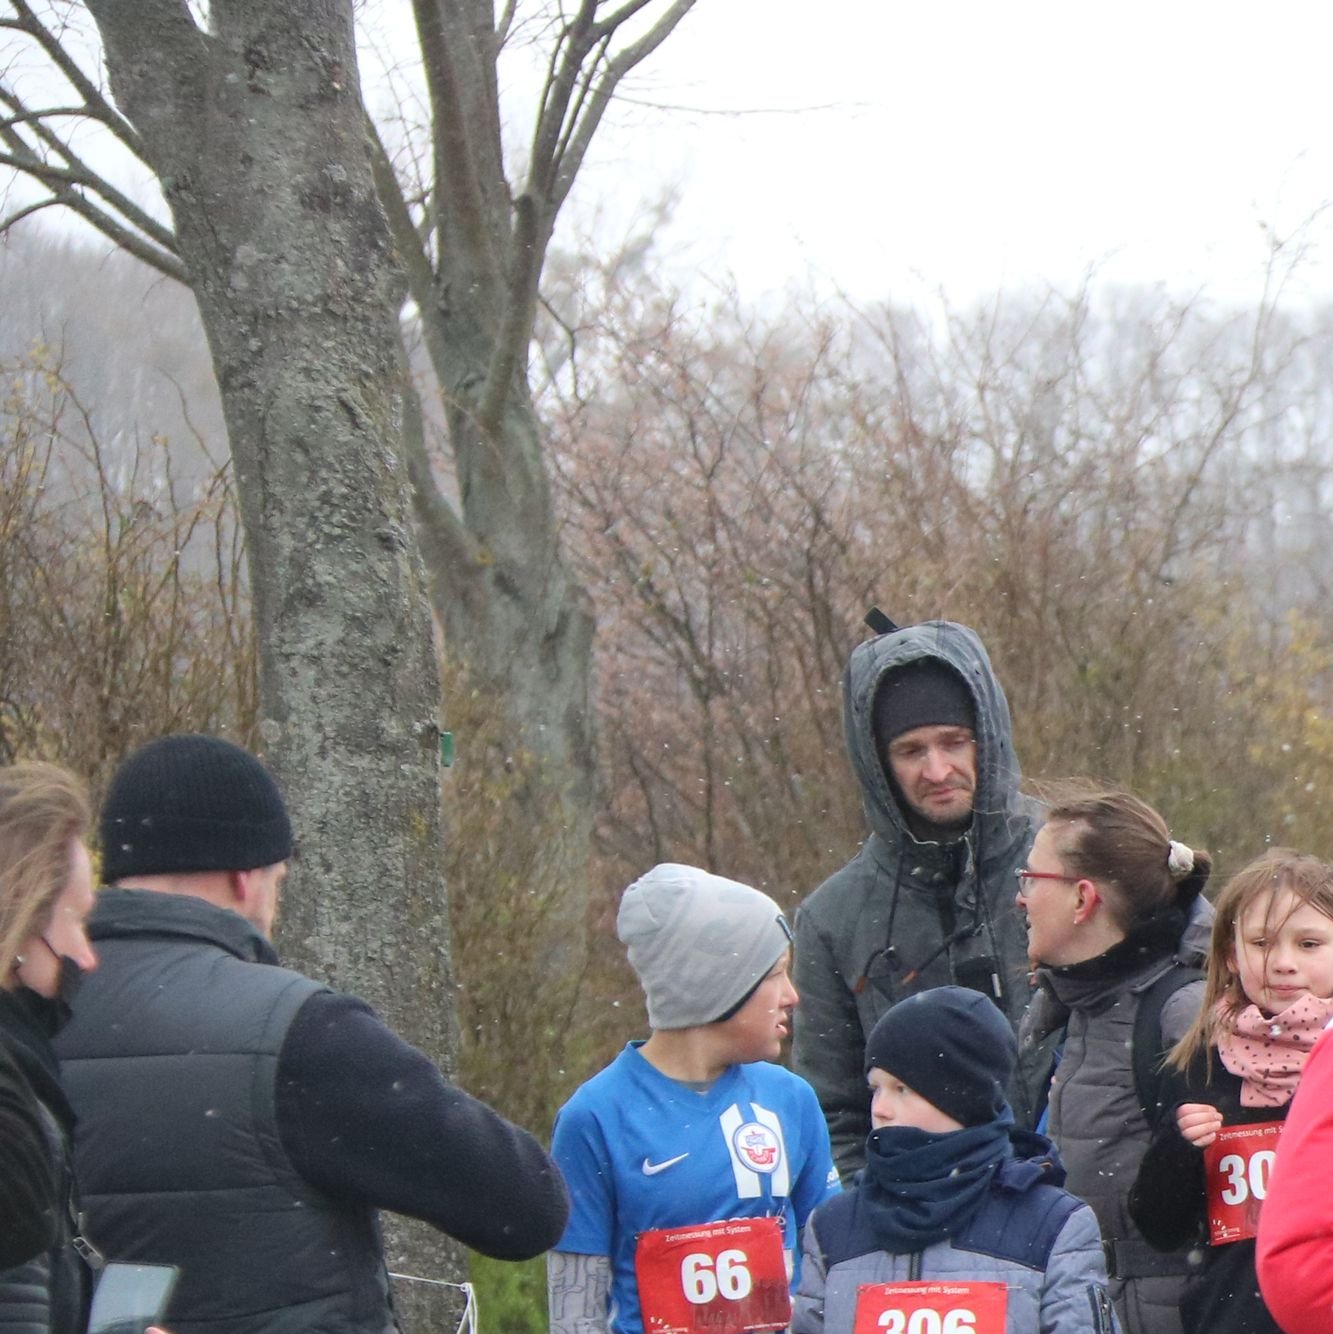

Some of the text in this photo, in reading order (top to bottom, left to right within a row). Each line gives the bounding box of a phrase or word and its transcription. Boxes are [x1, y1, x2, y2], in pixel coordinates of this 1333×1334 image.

[1220, 1128, 1263, 1141] Zeitmessung
[1264, 1126, 1277, 1135] mit
[665, 1225, 751, 1243] Zeitmessung mit System
[681, 1249, 751, 1304] 66
[884, 1286, 970, 1296] Zeitmessung mit System
